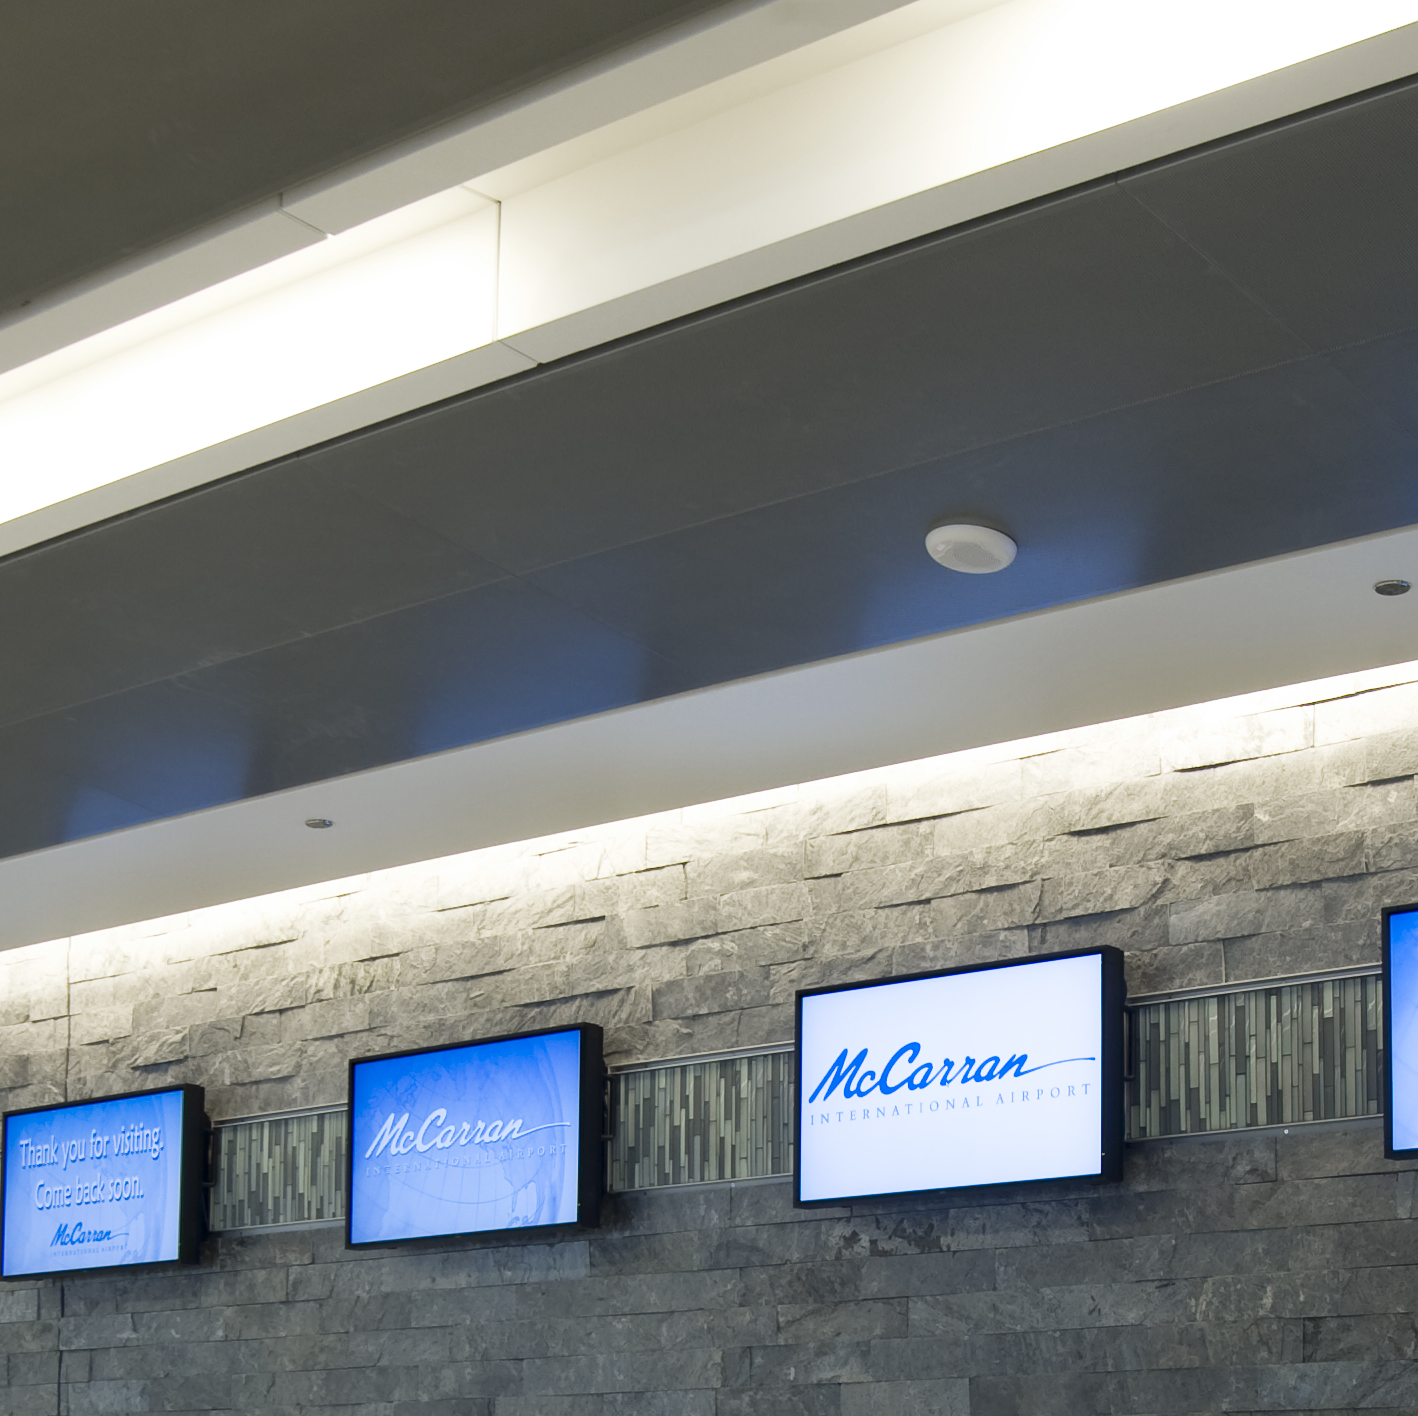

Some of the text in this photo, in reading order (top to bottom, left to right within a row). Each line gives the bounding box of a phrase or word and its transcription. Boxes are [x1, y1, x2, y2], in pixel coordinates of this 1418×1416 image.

[809, 1041, 1096, 1104] McCarran
[810, 1083, 1092, 1125] INTERNATIONAL AIRPORT
[20, 1123, 164, 1170] Thank you for visiting.
[366, 1108, 571, 1159] McCarran
[366, 1143, 567, 1177] INTERNATIONAL AIRPORT
[34, 1174, 144, 1211] Come back soon.
[50, 1222, 129, 1247] McCarran
